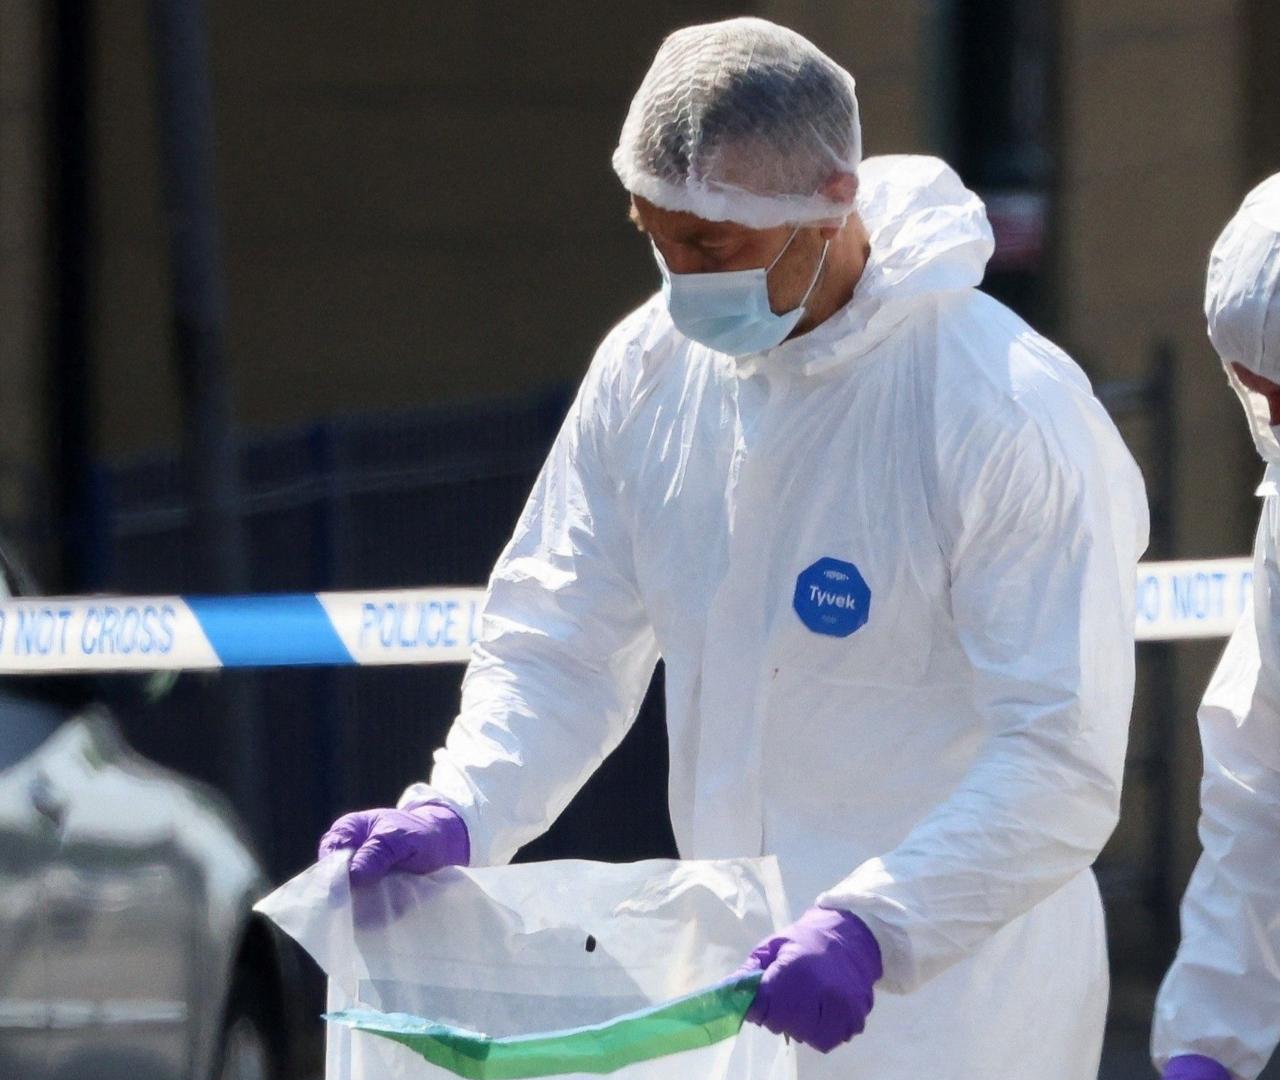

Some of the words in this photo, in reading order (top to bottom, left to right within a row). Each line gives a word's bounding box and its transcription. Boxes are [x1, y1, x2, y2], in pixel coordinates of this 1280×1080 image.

[809, 585, 856, 610] Tyvek
[1171, 572, 1226, 620] NOT
[14, 606, 72, 656] NOT
[81, 604, 176, 655] CROSS
[359, 601, 459, 648] POLICE
